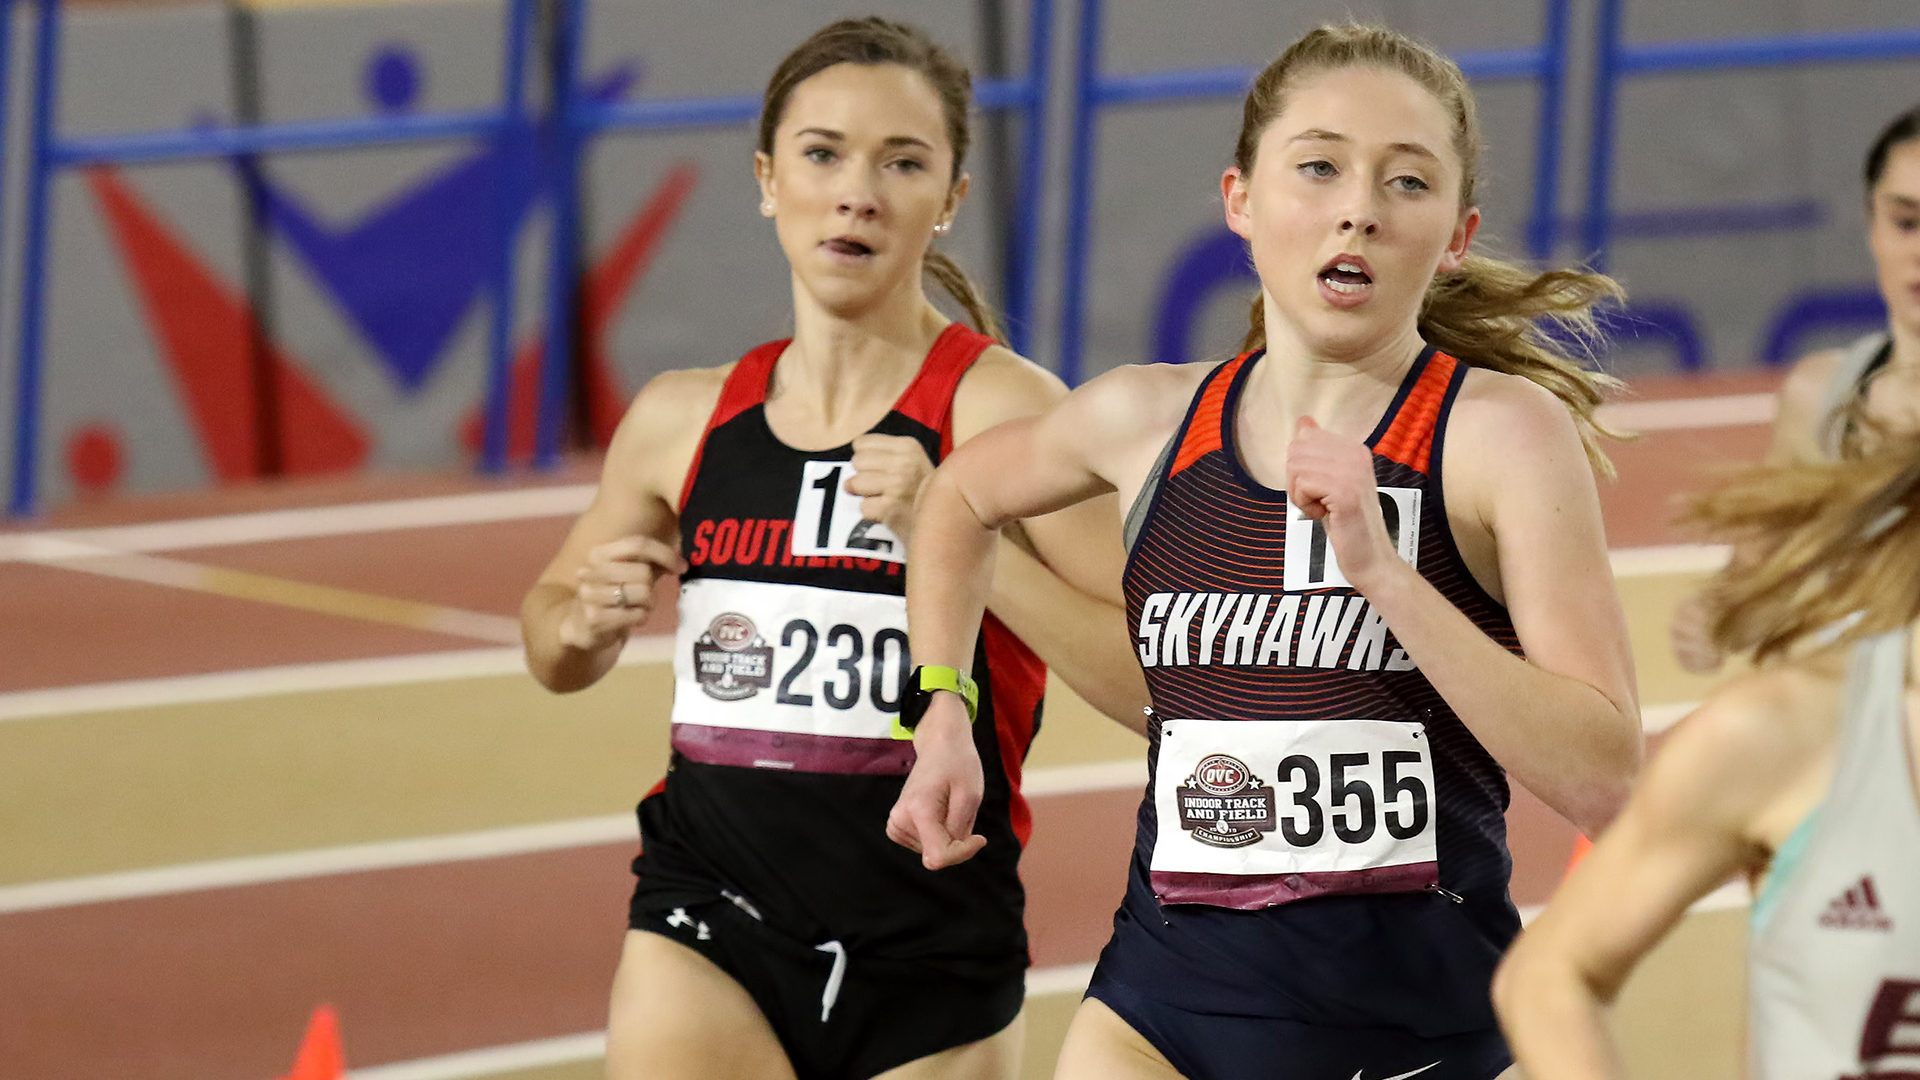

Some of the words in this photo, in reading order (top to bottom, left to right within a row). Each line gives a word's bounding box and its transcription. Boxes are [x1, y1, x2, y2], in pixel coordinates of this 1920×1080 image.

[776, 619, 911, 713] 230
[1206, 768, 1235, 783] OVC
[1184, 797, 1222, 809] INDOOR
[1224, 798, 1267, 809] TRACK
[1277, 750, 1428, 847] 355
[1186, 809, 1214, 819] AND
[1219, 809, 1267, 820] FIELD
